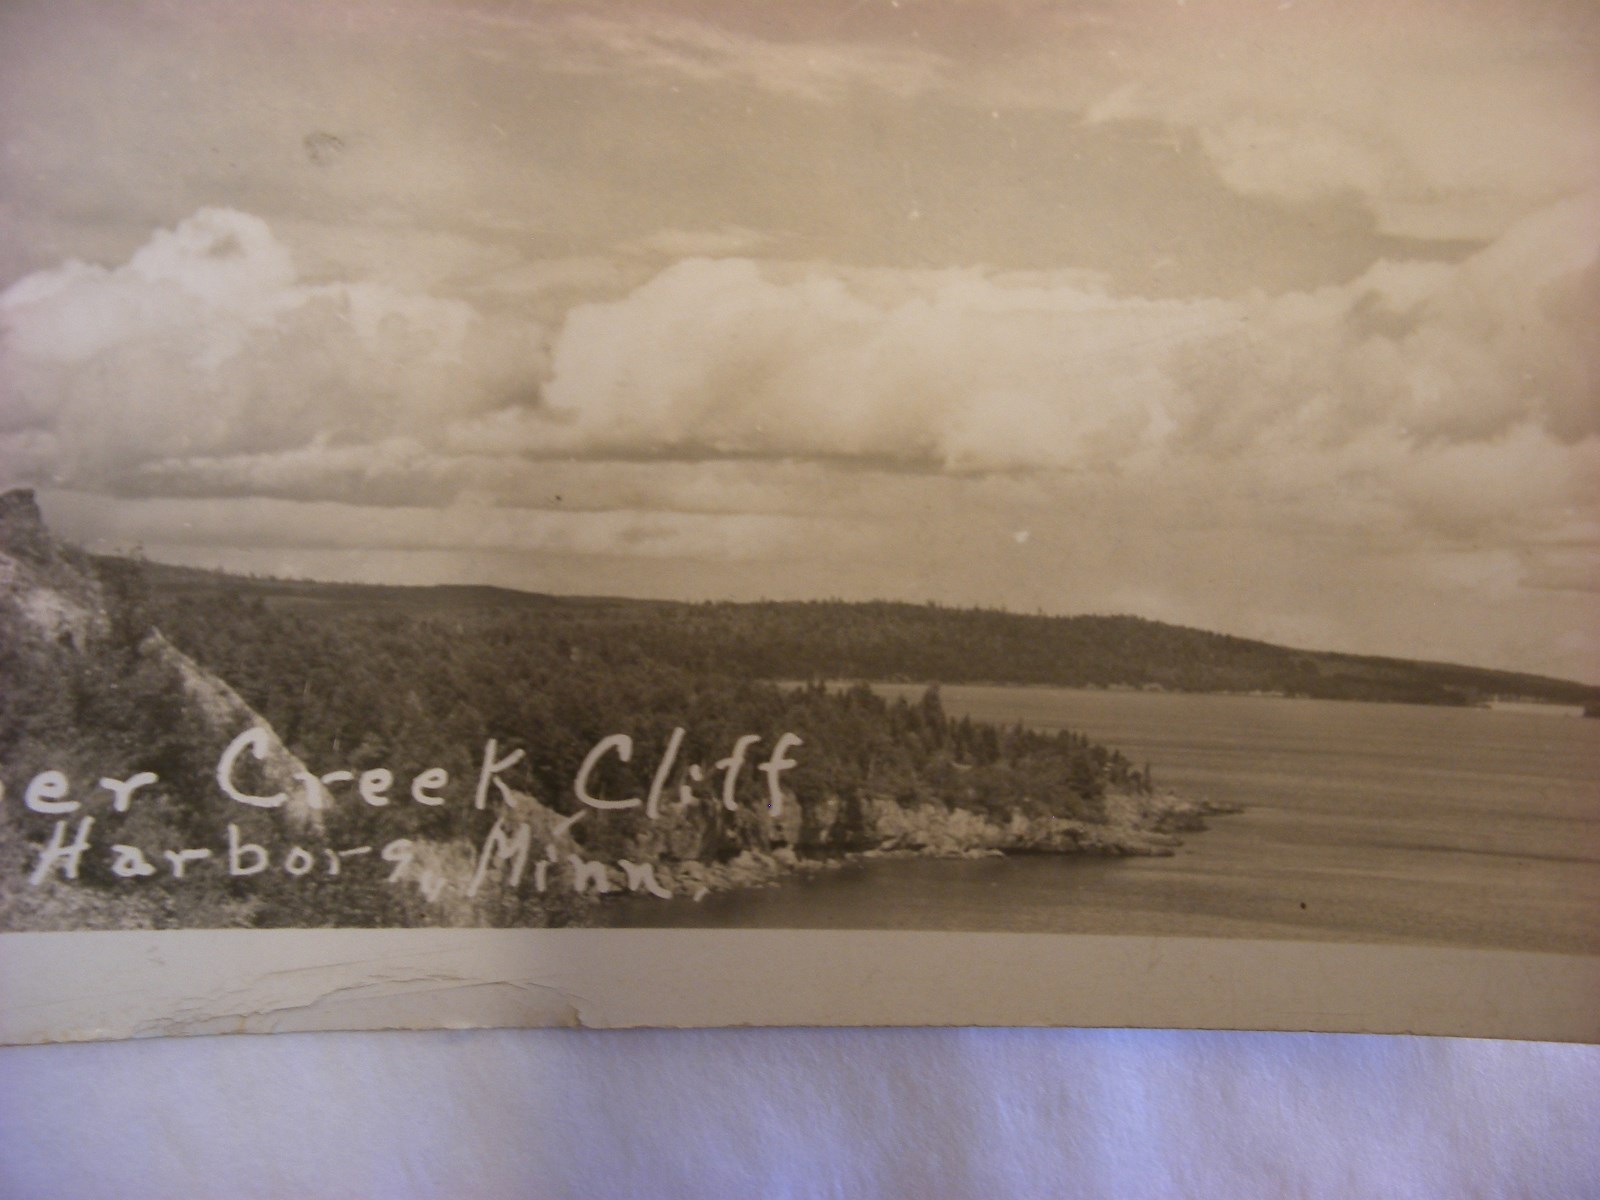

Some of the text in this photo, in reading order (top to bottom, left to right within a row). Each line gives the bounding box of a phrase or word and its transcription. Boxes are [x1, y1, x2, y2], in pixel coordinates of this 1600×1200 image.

[0, 727, 802, 820] er Creek Cliff
